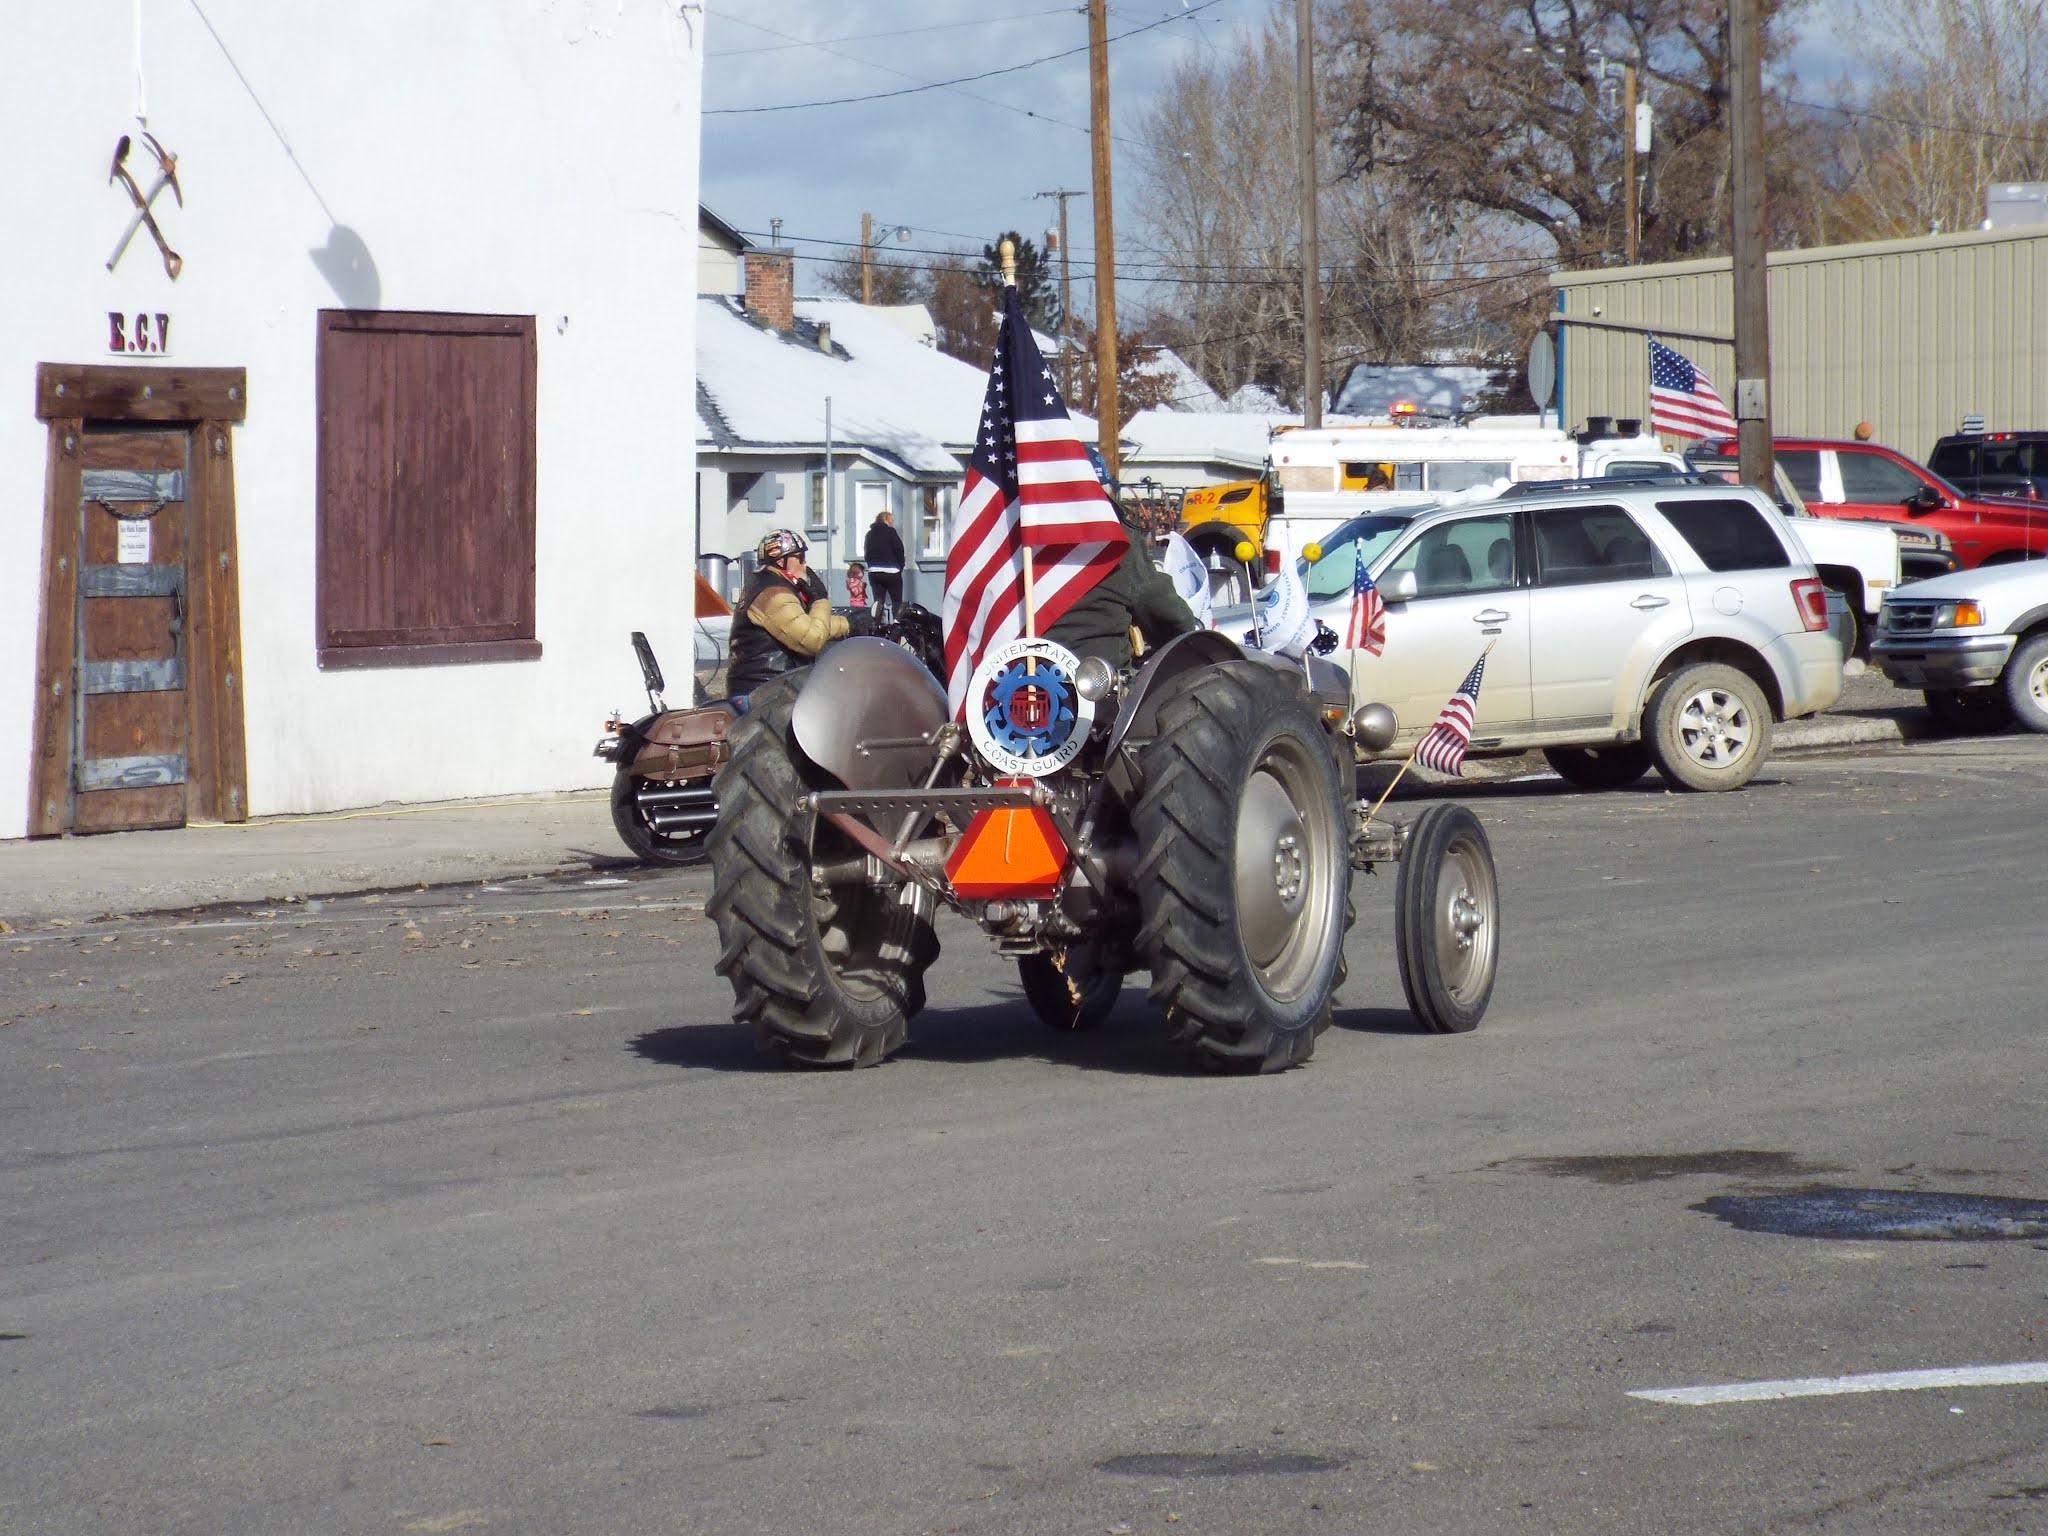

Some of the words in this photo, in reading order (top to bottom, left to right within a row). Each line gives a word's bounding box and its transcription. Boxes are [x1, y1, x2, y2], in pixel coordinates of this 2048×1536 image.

[1194, 492, 1215, 504] R-2
[1897, 535, 1928, 543] ON
[1281, 598, 1291, 620] COAST
[983, 643, 1028, 676] UNITED
[983, 741, 1028, 772] COAST
[1032, 740, 1078, 772] GUARD
